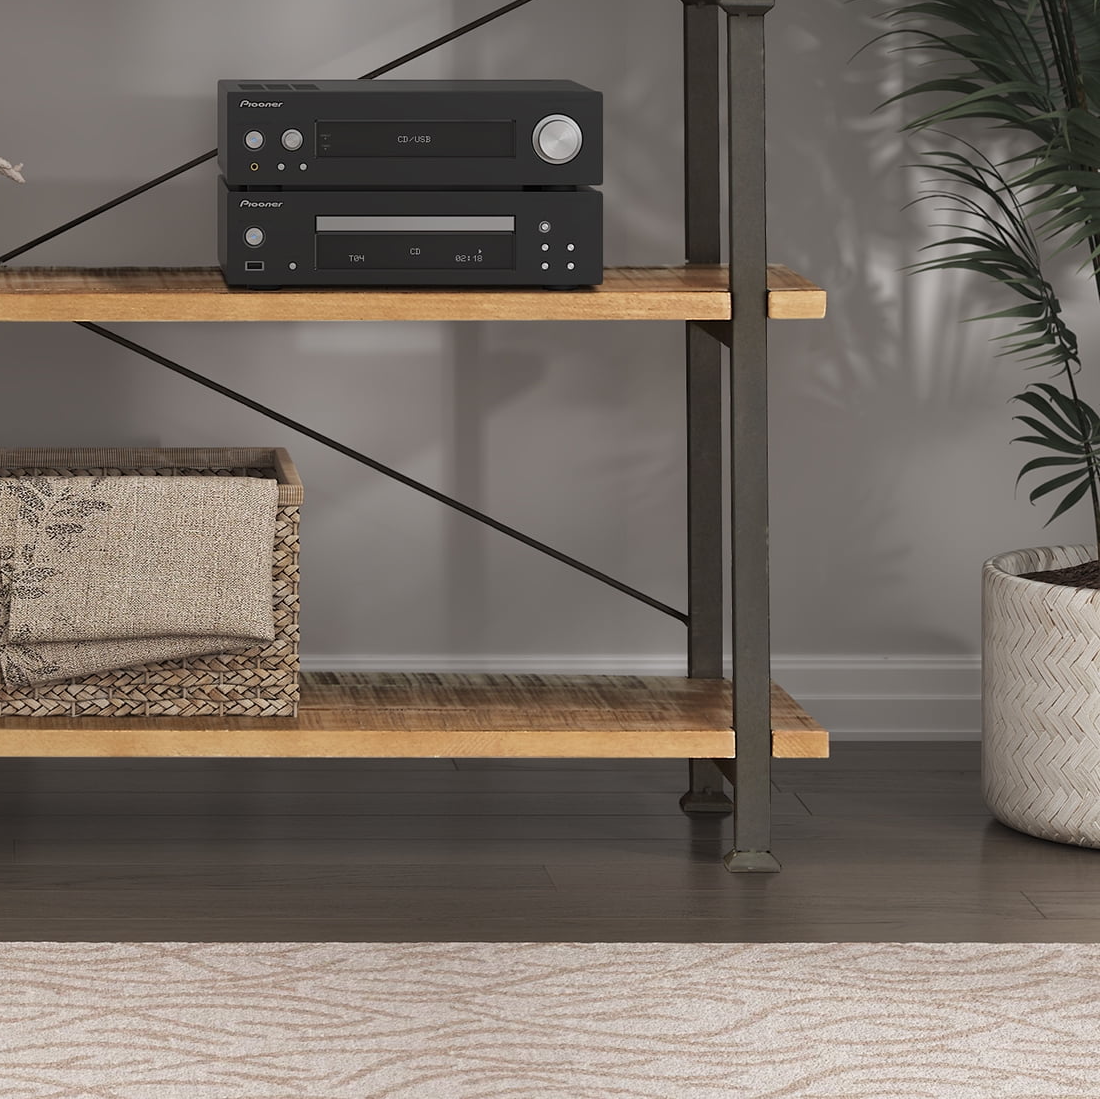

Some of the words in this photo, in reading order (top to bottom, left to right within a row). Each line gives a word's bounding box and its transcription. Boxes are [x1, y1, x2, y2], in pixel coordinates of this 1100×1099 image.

[397, 135, 432, 143] CD/USB
[409, 247, 421, 256] CD
[348, 254, 365, 263] T04
[455, 254, 483, 263] 02:18
